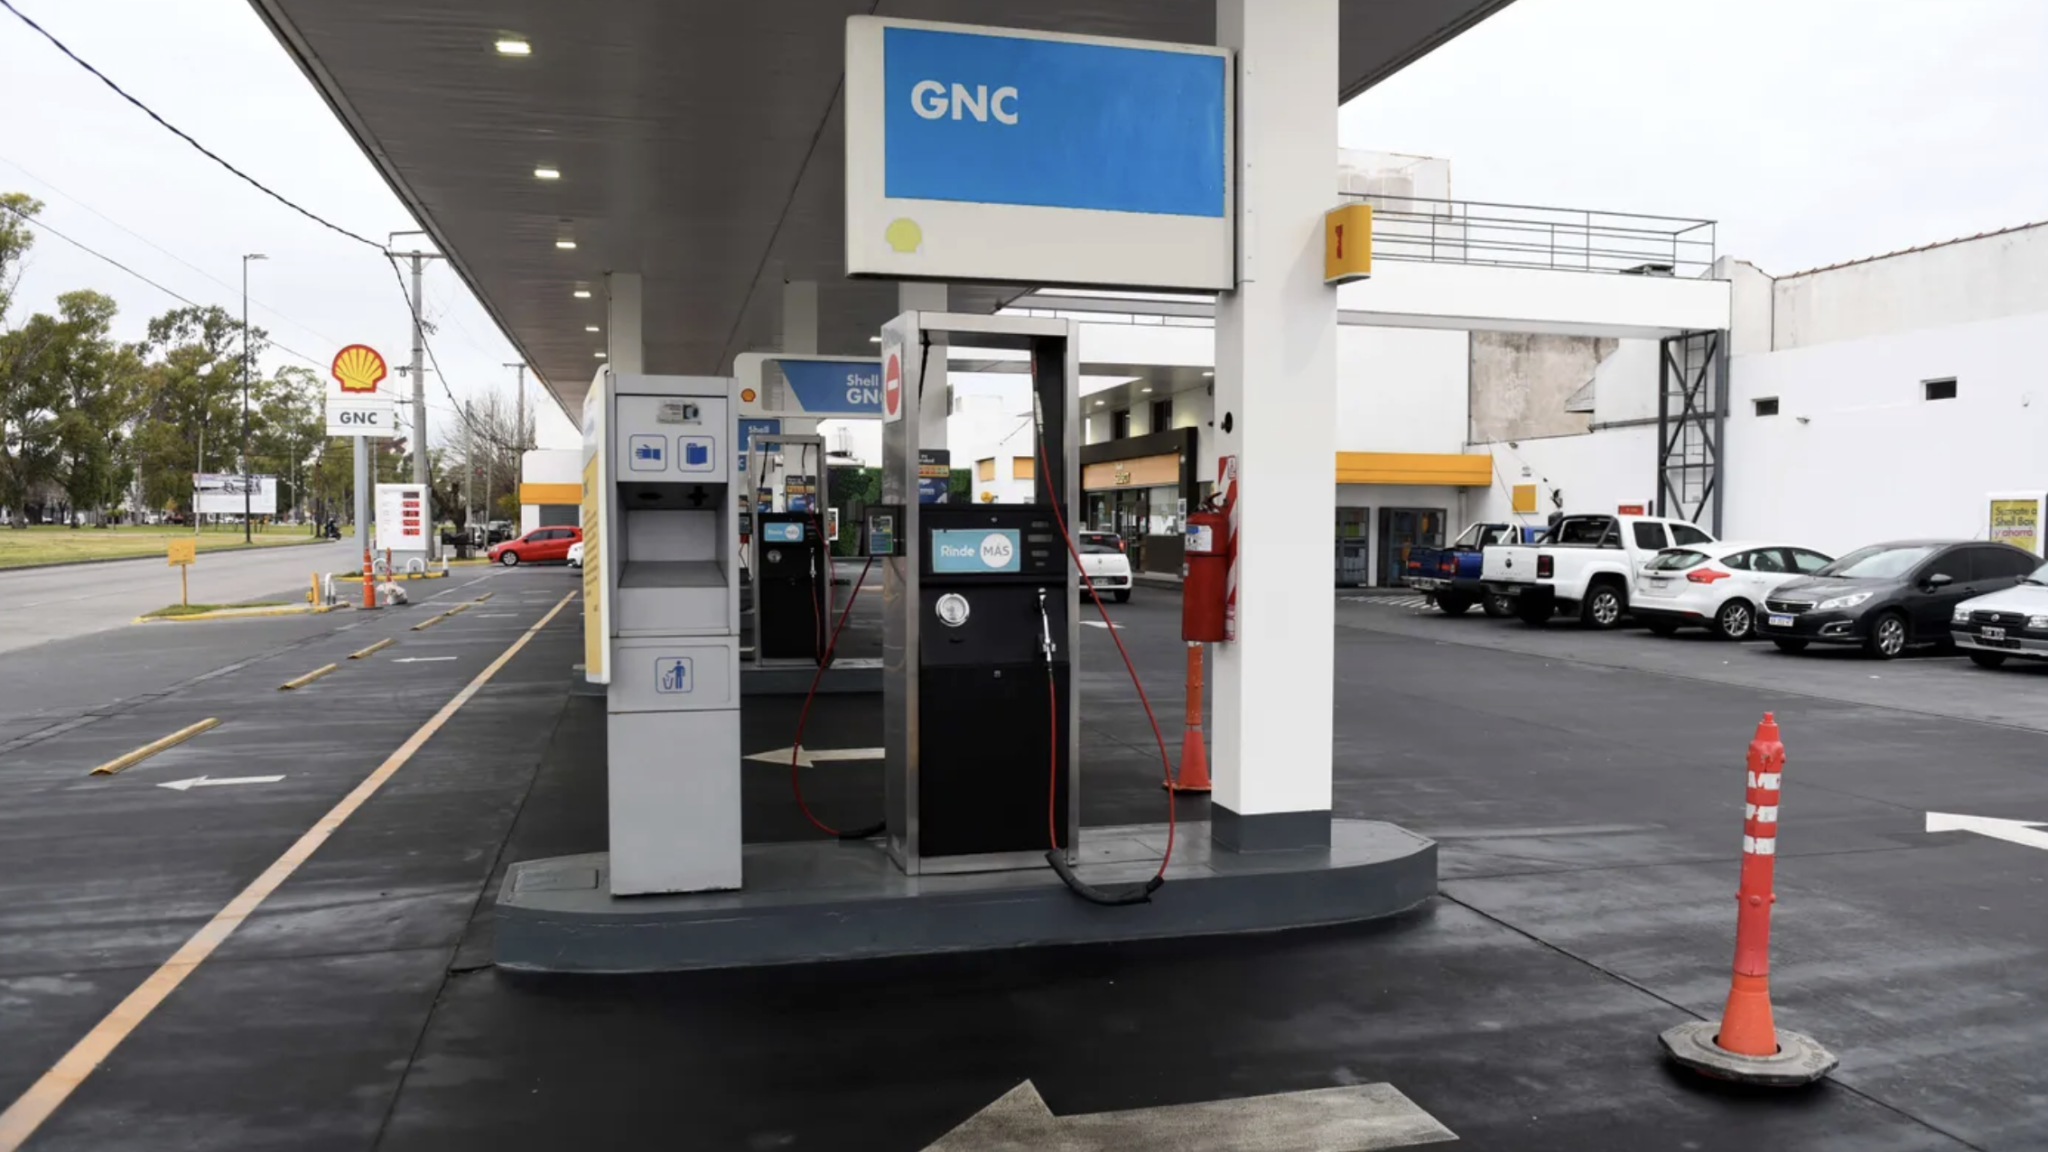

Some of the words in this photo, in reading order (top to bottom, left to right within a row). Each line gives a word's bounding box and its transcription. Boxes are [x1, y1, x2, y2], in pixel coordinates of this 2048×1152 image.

[911, 80, 1018, 125] GNC
[846, 374, 879, 387] Shell
[846, 388, 883, 404] GN
[340, 411, 378, 424] GNC
[940, 545, 976, 557] Rinde
[983, 544, 1010, 556] MÁS
